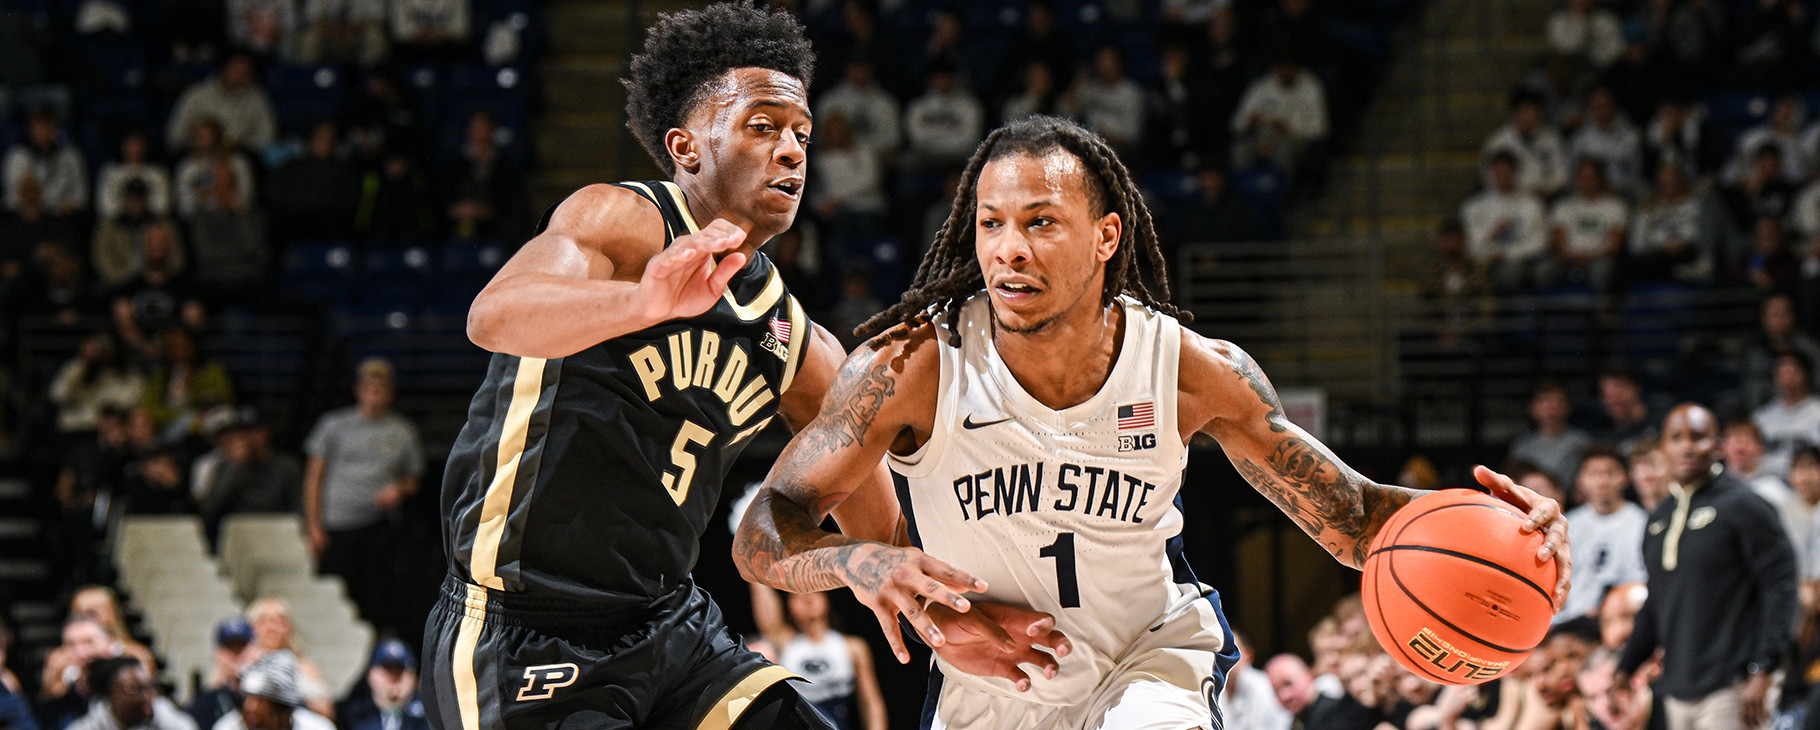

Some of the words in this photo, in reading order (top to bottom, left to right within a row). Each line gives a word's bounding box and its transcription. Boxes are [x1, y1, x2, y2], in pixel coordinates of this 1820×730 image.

[661, 419, 716, 507] 5
[953, 462, 1044, 521] PENN
[1053, 463, 1156, 523] STATE
[1039, 532, 1081, 608] 1
[1408, 632, 1505, 680] ELITE
[1422, 627, 1510, 667] CHAMPIONSHIP
[516, 662, 579, 701] P
